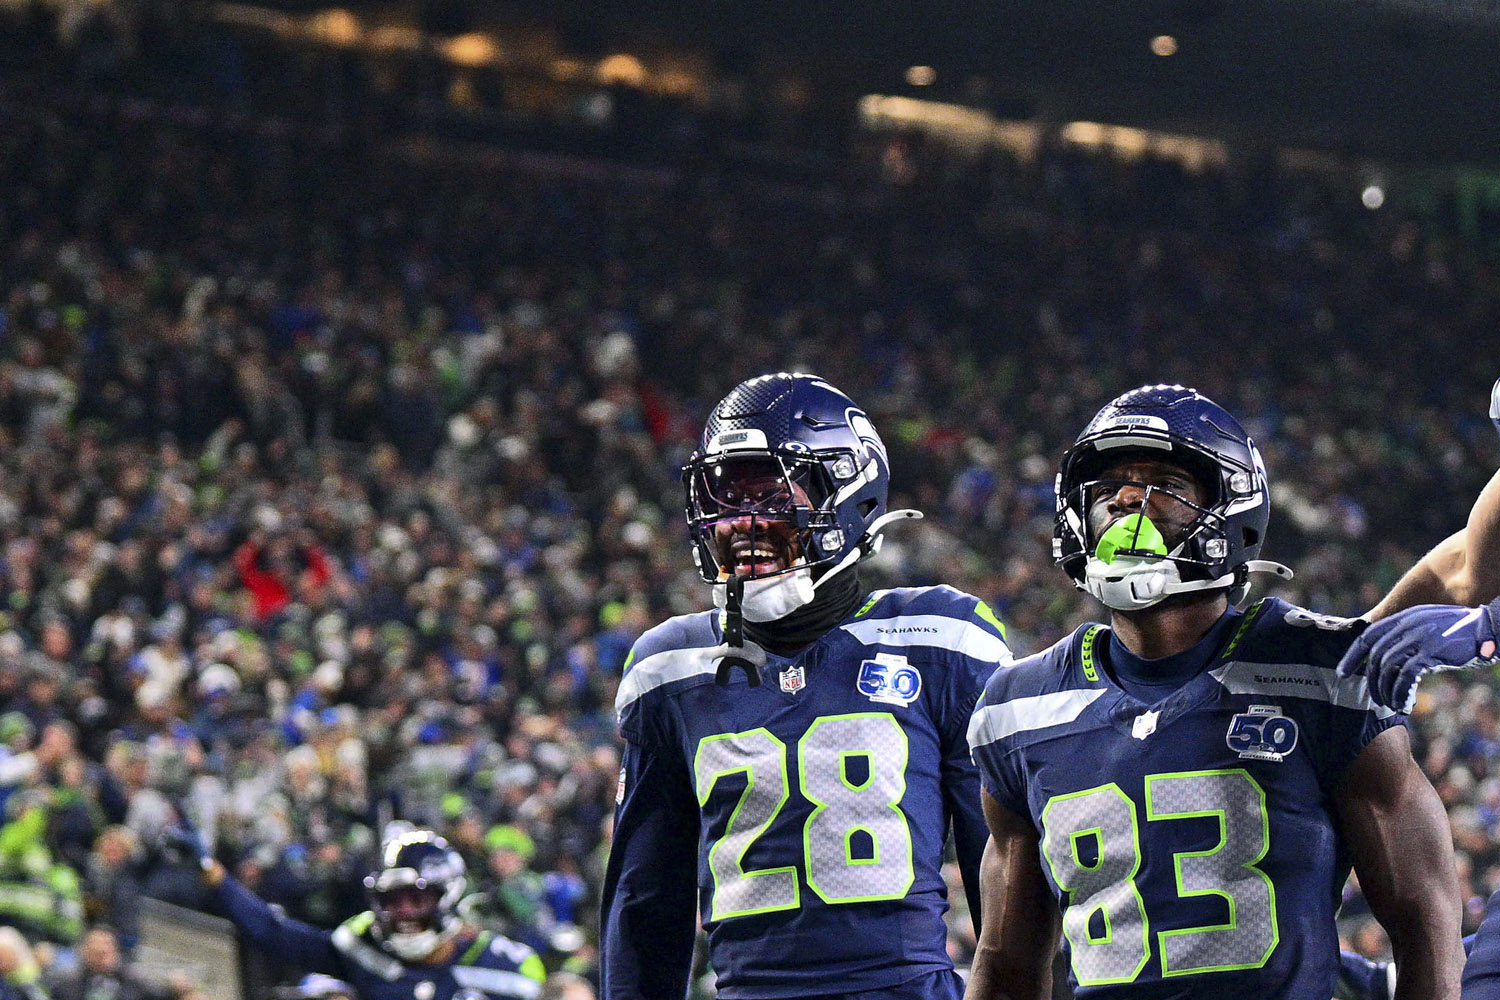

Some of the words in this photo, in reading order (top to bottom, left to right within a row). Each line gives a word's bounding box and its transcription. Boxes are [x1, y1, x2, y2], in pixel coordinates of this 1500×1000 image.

[876, 626, 938, 635] SEAHAWKS
[859, 661, 920, 700] 50
[1253, 674, 1321, 687] SEAHAWKS
[1228, 714, 1298, 755] 50
[694, 712, 915, 922] 28
[1041, 767, 1280, 987] 83
